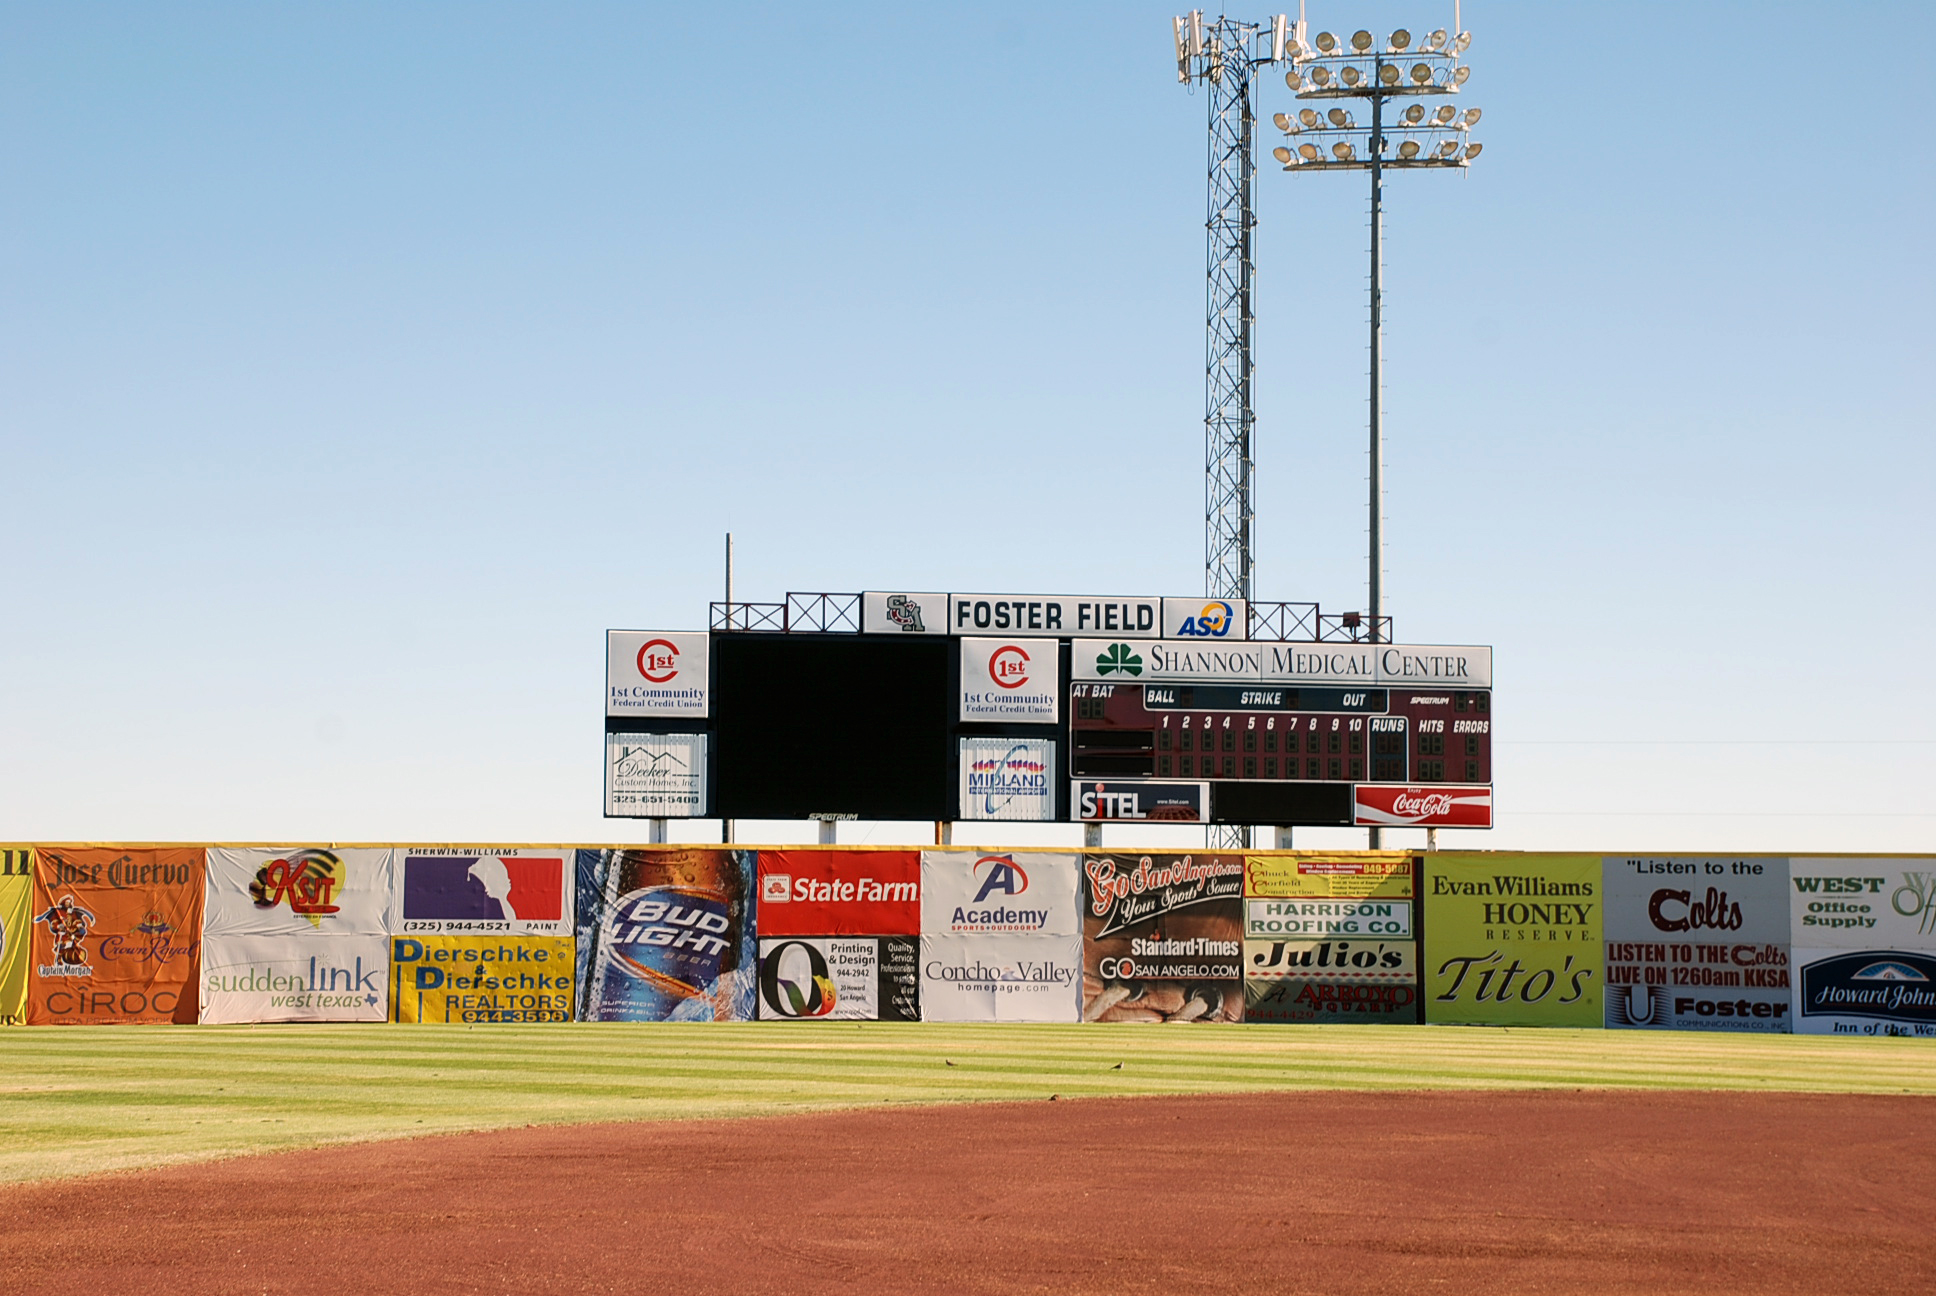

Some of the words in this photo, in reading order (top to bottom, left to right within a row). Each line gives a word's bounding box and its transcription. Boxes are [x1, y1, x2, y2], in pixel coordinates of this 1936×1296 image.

[958, 601, 1062, 629] FOSTER
[1078, 603, 1154, 631] FIELD
[1177, 601, 1235, 637] ASU
[647, 653, 675, 671] 1st
[999, 660, 1026, 678] 1st
[1151, 645, 1260, 673] SHANNON
[1271, 647, 1372, 675] MEDICAL
[1382, 648, 1469, 678] CENTER
[611, 686, 629, 697] 1st
[632, 686, 705, 701] Community
[1073, 685, 1088, 698] AT
[1092, 685, 1114, 698] BAT
[1147, 690, 1175, 703] BALL
[1240, 692, 1282, 705] STRIKE
[613, 698, 645, 707] Federal
[647, 699, 675, 708] Credit
[677, 699, 703, 708] Union
[964, 692, 981, 703] 1st
[984, 692, 1055, 707] Community
[1342, 693, 1366, 707] OUT
[1410, 696, 1450, 705] SPECTRUM
[966, 704, 997, 713] Federal
[999, 705, 1026, 714] Credit
[1028, 705, 1053, 714] Union
[1162, 715, 1169, 728] 1
[1182, 716, 1190, 728] 2
[1204, 716, 1212, 729] 3
[1222, 716, 1231, 729] 4
[1247, 716, 1256, 730] 5
[1266, 717, 1275, 730] 6
[1290, 717, 1298, 731] 7
[1309, 718, 1317, 731] 8
[1331, 718, 1340, 732] 9
[1349, 718, 1362, 732] 10
[1372, 719, 1405, 732] RUNS
[1418, 719, 1444, 733] HITS
[1453, 720, 1489, 733] ERRORS
[614, 777, 647, 787] Custom
[648, 778, 679, 788] Homes,
[969, 773, 1046, 787] MIDLAND
[1393, 793, 1453, 817] Coca-Cola
[408, 847, 519, 856] SHERWIN-WILLIAMS
[46, 854, 103, 890] Jose
[1627, 860, 1697, 875] "Listen
[1704, 861, 1724, 875] to
[1731, 861, 1764, 875] the
[267, 858, 340, 914] KSJT
[1432, 875, 1494, 896] Evan
[1492, 875, 1594, 897] Williams
[1793, 877, 1885, 894] WEST
[1120, 898, 1156, 924] Your
[1161, 887, 1198, 910] Sports
[1206, 878, 1240, 896] Source
[1807, 902, 1871, 914] Office
[627, 900, 729, 934] BUD
[951, 906, 1048, 928] Academy
[1266, 904, 1392, 917] HARRISON
[1482, 902, 1594, 925] HONEY
[1648, 886, 1743, 933] Colts
[403, 921, 442, 931] (325)
[446, 922, 511, 931] 944-4521
[1250, 920, 1359, 933] ROOFING
[1368, 920, 1408, 933] CO.
[1803, 915, 1878, 929] Supply
[606, 922, 731, 956] LIGHT
[1486, 929, 1590, 941] RESERVE
[100, 935, 147, 962] Crown
[142, 936, 201, 964] Royal
[394, 938, 549, 963] Dierschke
[831, 943, 873, 955] Printing
[887, 942, 915, 954] Quality,
[1253, 942, 1403, 969] Julio's
[1608, 943, 1666, 962] LISTEN
[1670, 945, 1692, 963] TO
[1696, 945, 1729, 964] THE
[1730, 944, 1788, 967] Colts
[828, 955, 837, 965] &
[839, 955, 876, 967] Design
[890, 953, 915, 963] Service,
[38, 964, 64, 978] Captain
[64, 964, 92, 977] Morgan
[207, 955, 379, 992] suddenlink
[475, 964, 487, 976] &
[836, 968, 870, 977] 944-2942
[925, 960, 1001, 981] Concho
[1016, 961, 1077, 988] Valley
[1434, 949, 1594, 1005] Tito's
[1607, 965, 1641, 984] LIVE
[1644, 966, 1667, 985] ON
[1671, 967, 1740, 987] 1260am
[1744, 968, 1790, 988] KKSA
[415, 966, 571, 990] Dierschke
[958, 983, 1049, 993] homepage.com
[1294, 983, 1415, 1007] ARROYO
[1815, 985, 1890, 1005] Howard
[46, 986, 177, 1015] CÎROC
[271, 993, 312, 1008] west
[316, 993, 363, 1008] texas
[446, 994, 568, 1009] REALTORS
[601, 1000, 646, 1008] SUPERIOR
[850, 994, 867, 1002] Angelo
[1675, 998, 1788, 1018] Foster
[464, 1011, 565, 1023] 944-3596
[1676, 1020, 1750, 1029] COMMUNICATIONS
[1833, 1022, 1858, 1033] Inn
[1864, 1022, 1880, 1036] of
[1884, 1023, 1908, 1035] the
